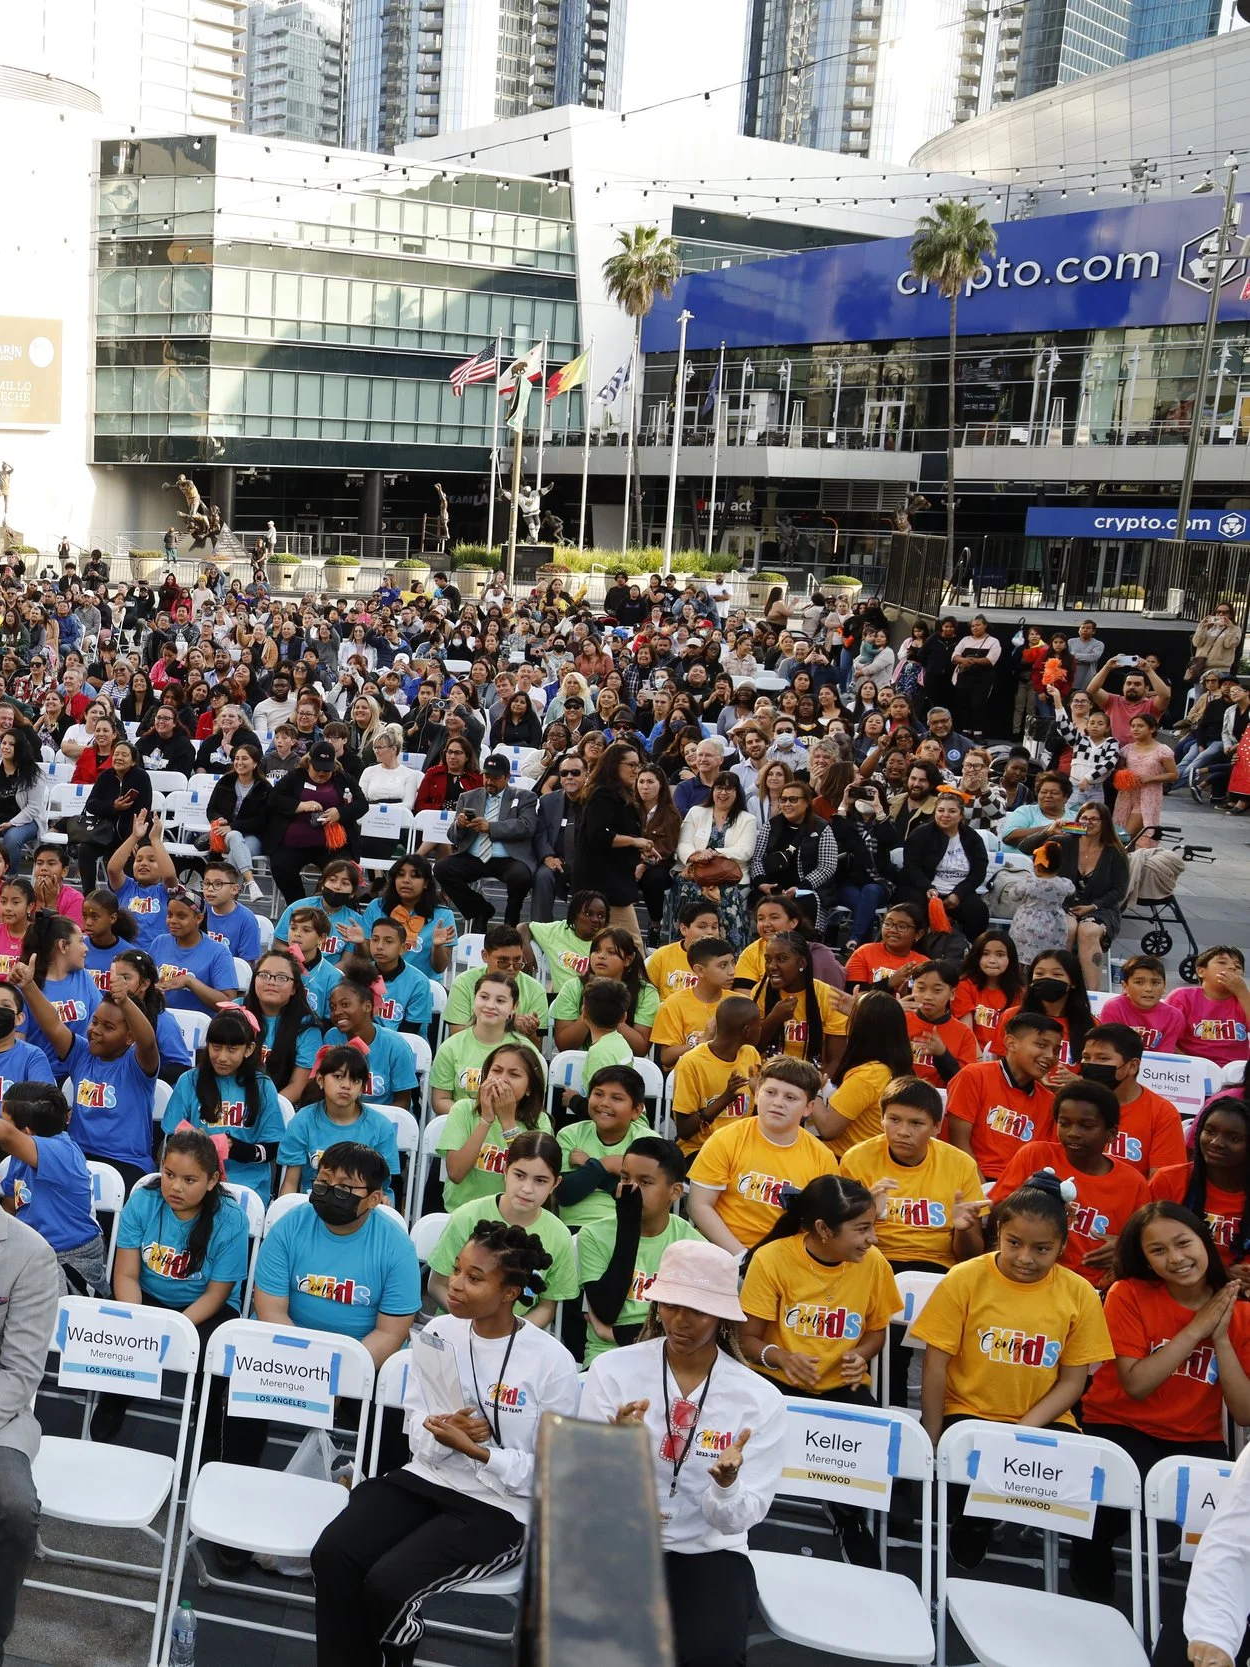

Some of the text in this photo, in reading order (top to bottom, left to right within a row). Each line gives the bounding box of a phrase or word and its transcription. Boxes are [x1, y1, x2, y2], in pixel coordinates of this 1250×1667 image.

[896, 250, 1160, 298] crpto.com
[1142, 1068, 1191, 1084] Sunkist
[1164, 1084, 1179, 1092] Hop
[886, 1197, 947, 1227] Kids
[146, 1242, 202, 1280] Kid
[297, 1274, 370, 1306] Conga Kids
[785, 1303, 862, 1340] Conga Kids
[67, 1326, 159, 1352] Wadsworth
[980, 1326, 1061, 1369] Conga Kids
[90, 1348, 134, 1363] Merengue
[85, 1365, 135, 1379] LOS ANGELES
[236, 1355, 330, 1382] Wadsworth
[260, 1378, 305, 1393] Merengue
[255, 1395, 307, 1409] LOS ANGELES
[701, 1429, 734, 1450] Kid
[805, 1430, 862, 1453] Keller
[695, 1450, 720, 1459] 2022-202
[805, 1453, 857, 1470] Merengue
[807, 1472, 851, 1485] LYNWOOD
[1003, 1457, 1064, 1482] Keller
[1004, 1481, 1058, 1498] Merengue
[1005, 1496, 1051, 1511] LYNWOOD
